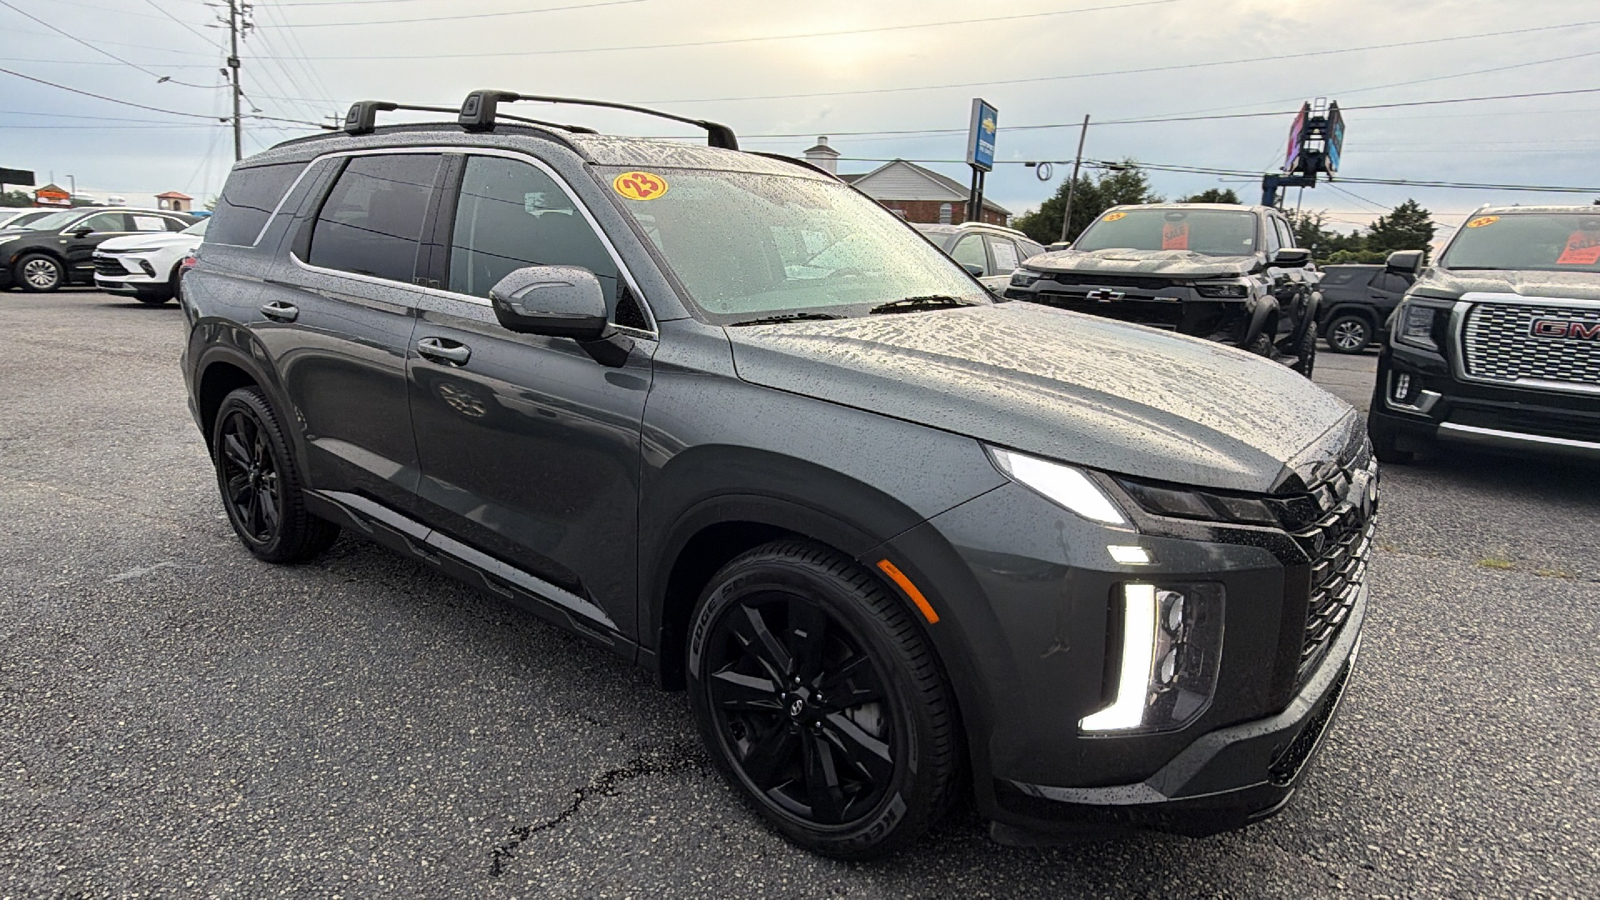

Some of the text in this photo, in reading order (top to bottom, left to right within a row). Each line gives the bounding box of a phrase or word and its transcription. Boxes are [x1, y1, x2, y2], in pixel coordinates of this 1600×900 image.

[623, 173, 659, 197] 23
[1165, 226, 1186, 242] SALE
[692, 597, 717, 655] EDGE
